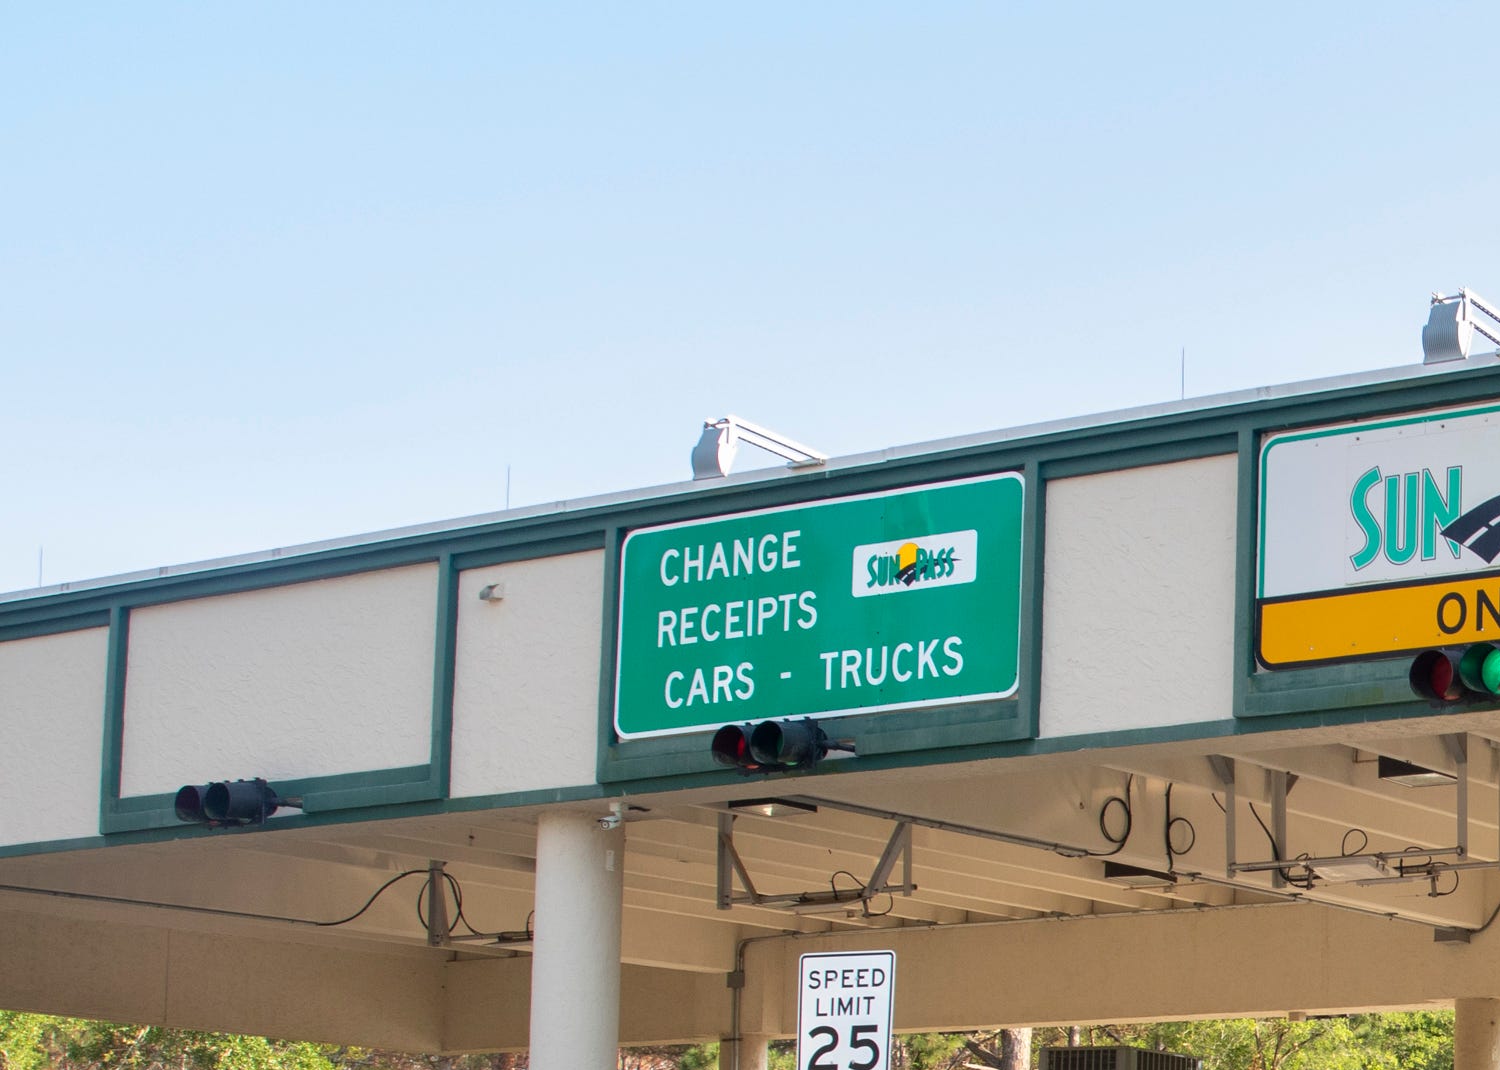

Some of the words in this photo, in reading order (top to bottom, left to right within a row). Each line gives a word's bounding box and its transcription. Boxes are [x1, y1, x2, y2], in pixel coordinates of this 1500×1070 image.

[1349, 465, 1463, 572] SUN
[660, 529, 801, 587] CHANGE
[867, 551, 901, 589] SUN
[915, 546, 956, 583] PASS
[657, 591, 818, 649] RECEIPTS
[664, 662, 755, 709] CARS
[820, 636, 965, 691] TRUCKS
[808, 968, 886, 990] SPEED
[816, 996, 876, 1017] LIMIT
